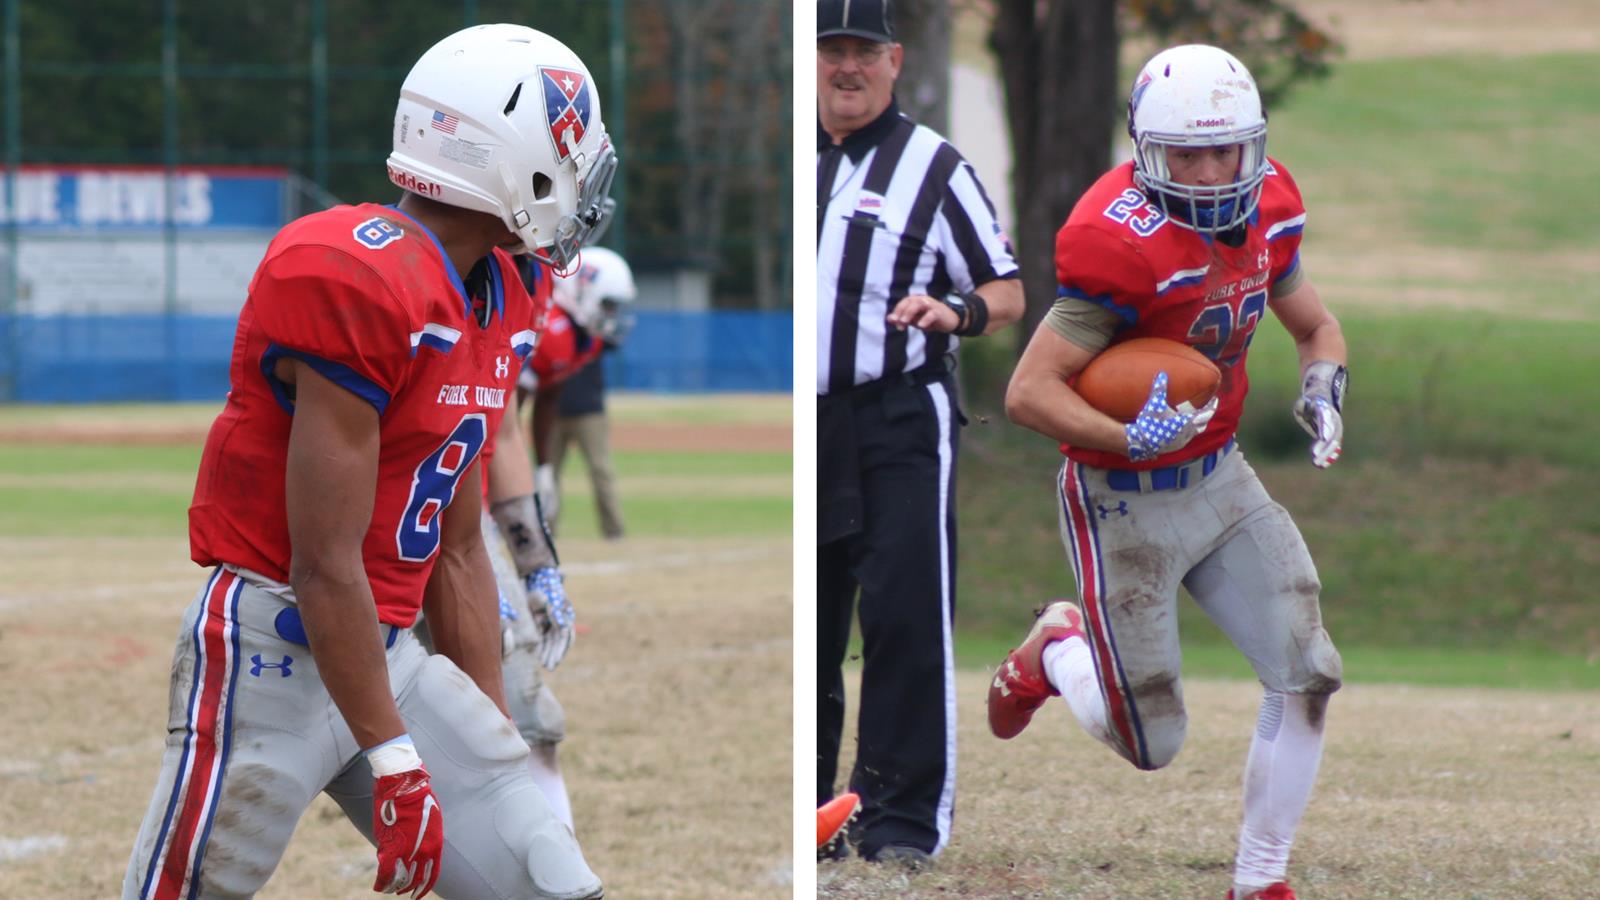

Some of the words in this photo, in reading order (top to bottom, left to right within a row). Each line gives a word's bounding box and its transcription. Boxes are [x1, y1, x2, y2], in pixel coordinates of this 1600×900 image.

[1196, 118, 1225, 128] Riddell
[1103, 188, 1169, 237] 23
[352, 216, 405, 250] 8
[437, 384, 469, 406] FORK
[396, 413, 488, 562] 8
